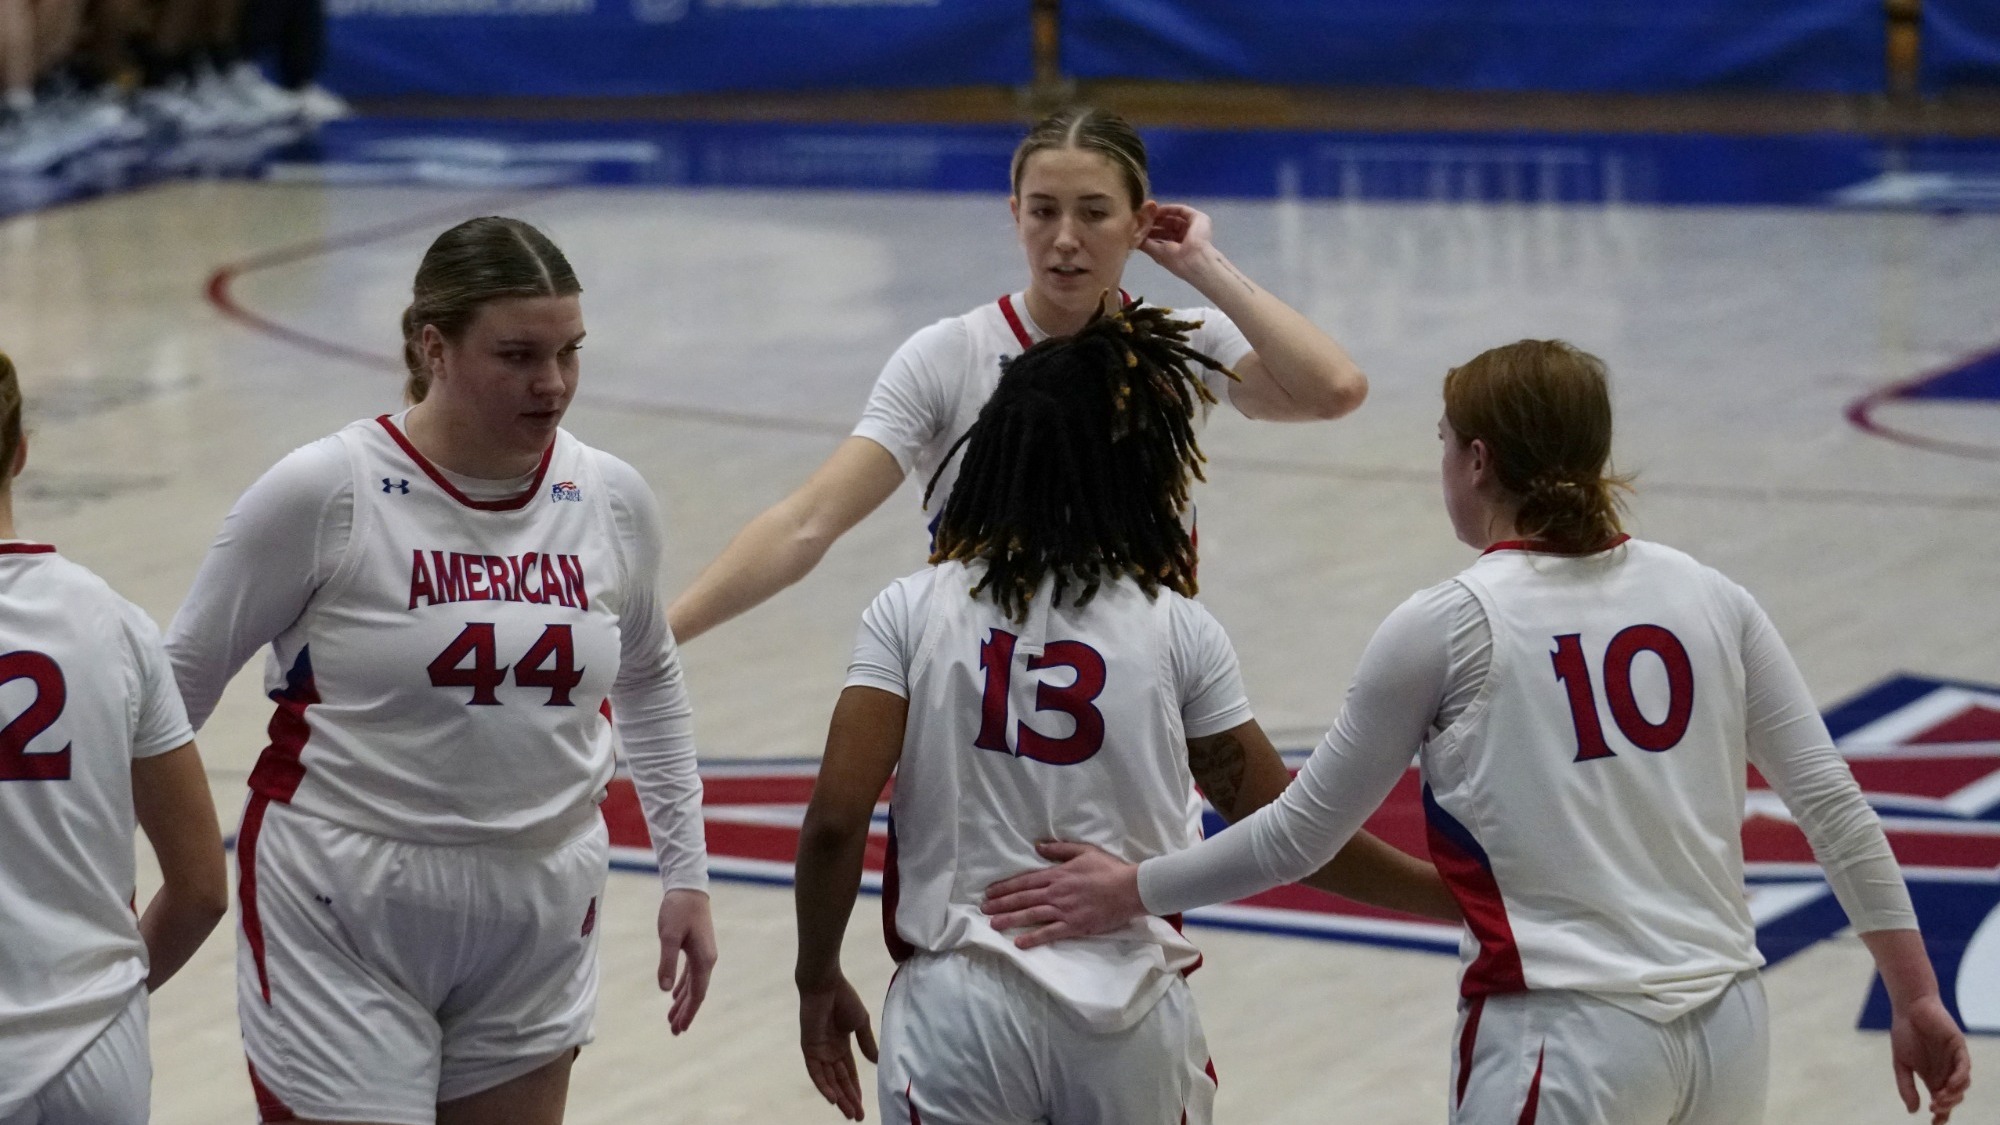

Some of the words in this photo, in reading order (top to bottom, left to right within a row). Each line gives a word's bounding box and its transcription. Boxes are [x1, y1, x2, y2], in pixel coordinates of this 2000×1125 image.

[408, 549, 589, 612] AMERICAN
[426, 622, 586, 706] 44
[973, 627, 1107, 766] 13
[1549, 623, 1694, 763] 10
